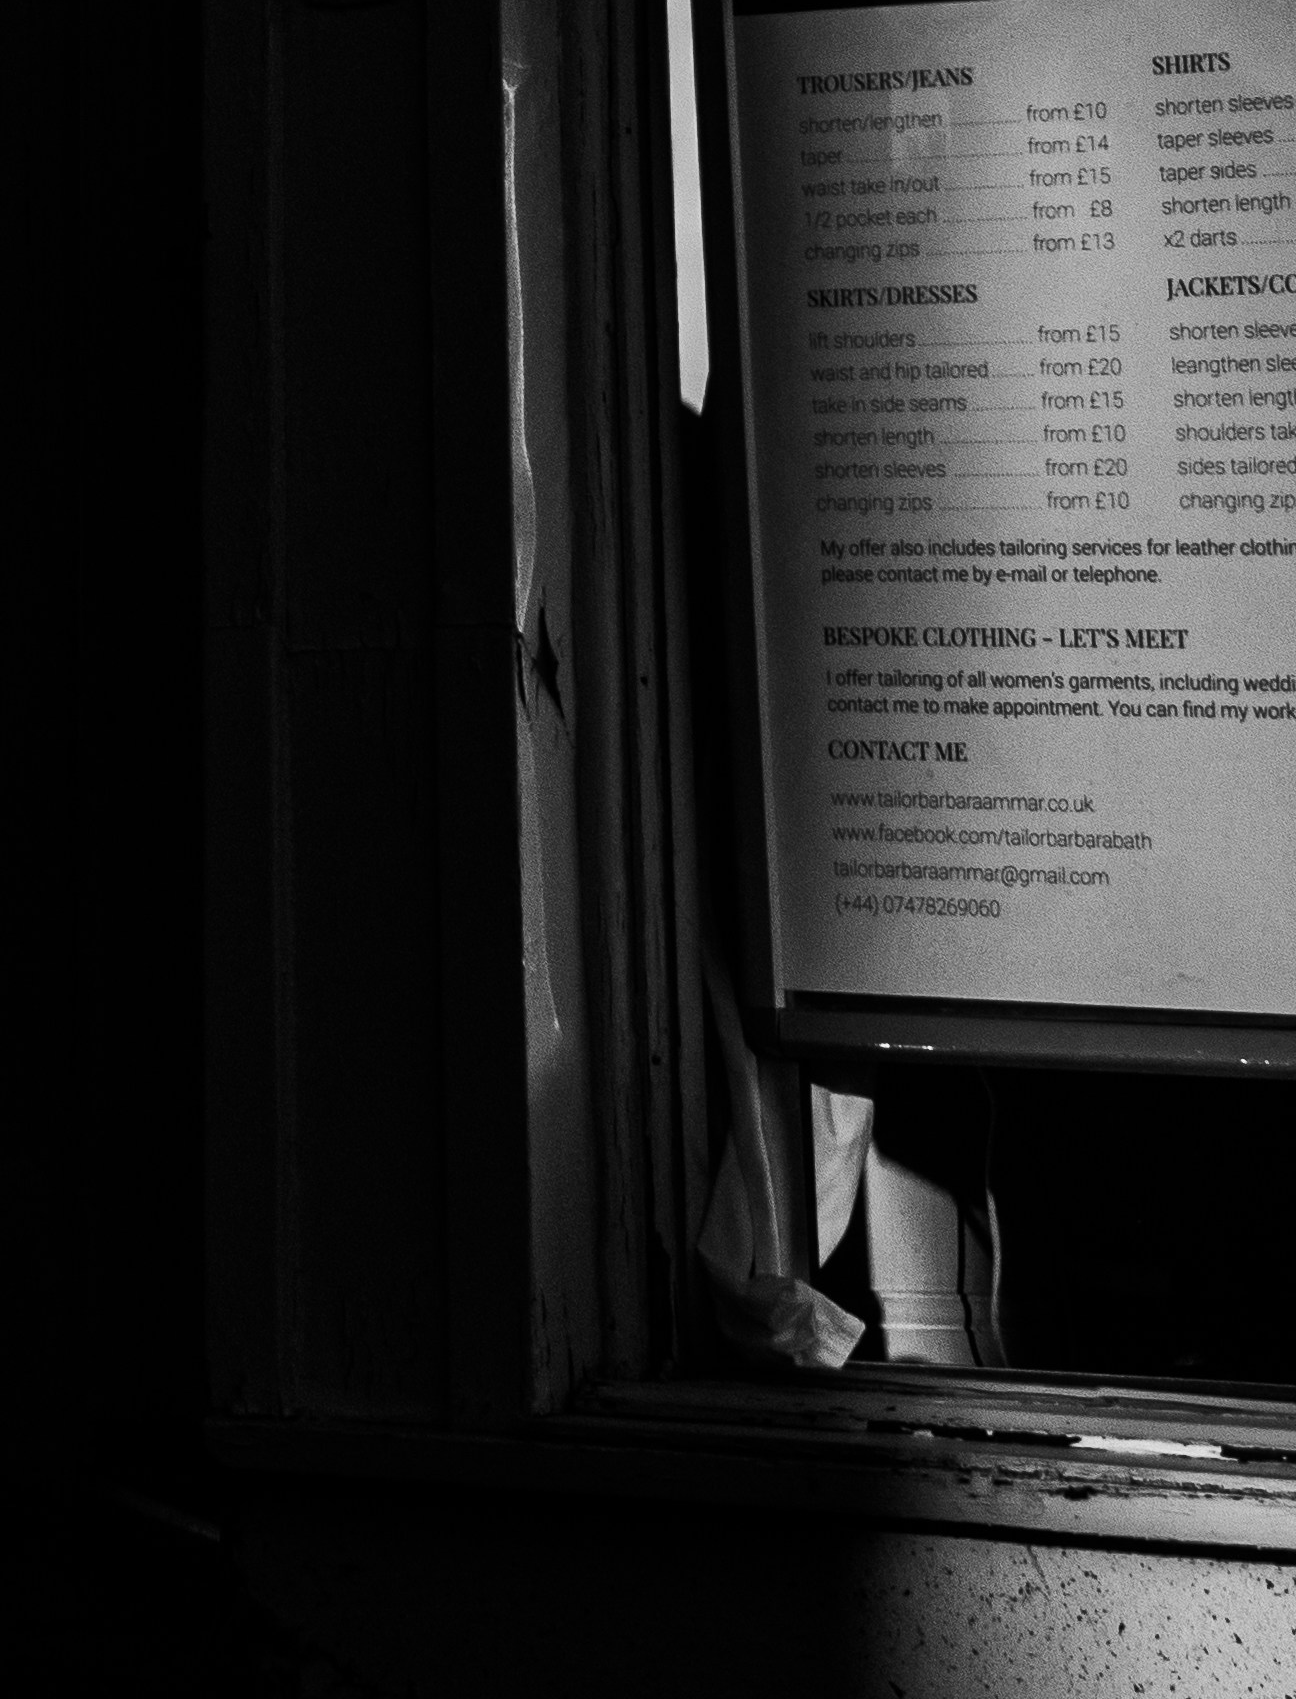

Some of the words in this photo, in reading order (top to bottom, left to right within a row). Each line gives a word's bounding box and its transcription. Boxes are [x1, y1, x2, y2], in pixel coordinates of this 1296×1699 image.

[1152, 52, 1231, 75] SHIRTS
[797, 67, 974, 94] TROUSERS/JEANS
[1026, 105, 1069, 122] from
[1073, 102, 1107, 121] £10
[1155, 98, 1222, 117] shorten
[1228, 94, 1294, 113] sleeves
[801, 150, 842, 167] taper
[1028, 137, 1070, 154] from
[1075, 135, 1109, 153] £14
[1157, 133, 1203, 151] taper
[1208, 129, 1274, 147] sleeves
[801, 180, 845, 197] waist
[851, 178, 886, 195] take
[890, 175, 940, 194] in/out
[1030, 169, 1072, 187] from
[1077, 167, 1111, 186] £15
[1159, 165, 1205, 184] taper
[1210, 161, 1257, 179] sides
[836, 209, 892, 228] pocket
[896, 209, 937, 224] each
[1033, 201, 1075, 219] from
[1090, 200, 1113, 218] £8
[1162, 195, 1230, 215] shorten
[1235, 191, 1291, 215] length
[805, 243, 882, 263] changing
[886, 241, 920, 260] zips
[1033, 233, 1075, 252] from
[1081, 232, 1115, 250] £13
[1164, 230, 1186, 247] x2
[1190, 228, 1238, 247] darts
[807, 284, 978, 308] SKIRTS/DRESSES
[834, 330, 916, 349] shoulders
[1038, 325, 1081, 342] from
[1086, 325, 1120, 342] £15
[1169, 323, 1239, 341] shorten
[811, 364, 855, 381] waist
[859, 362, 890, 381] and
[895, 362, 921, 383] hip
[925, 360, 989, 379] tailored
[1040, 358, 1082, 376] from
[1088, 358, 1122, 376] £20
[1172, 355, 1260, 378] leangthen
[812, 397, 846, 414] take
[852, 395, 866, 413] in
[871, 396, 905, 413] side
[909, 397, 967, 412] seams
[1041, 391, 1084, 409] from
[1090, 391, 1124, 409] £15
[1174, 389, 1243, 408] shorten
[1249, 388, 1296, 411] lengt
[814, 429, 877, 447] shorten
[882, 427, 934, 449] length
[1044, 425, 1086, 442] from
[1092, 424, 1126, 442] £10
[1175, 423, 1265, 442] shoulders
[815, 462, 879, 479] shorten
[883, 461, 946, 478] sleeves
[1045, 458, 1088, 476] from
[1094, 458, 1127, 476] £20
[1177, 457, 1225, 475] sides
[1231, 456, 1296, 475] tailored
[815, 495, 894, 515] changing
[899, 493, 933, 512] zips
[1047, 491, 1089, 510] from
[1096, 491, 1129, 509] £10
[1179, 492, 1264, 513] changing
[821, 540, 845, 560] My
[849, 538, 886, 556] offer
[890, 539, 924, 556] also
[928, 539, 995, 556] includes
[1000, 539, 1067, 560] tailoring
[1072, 539, 1142, 556] services
[1147, 538, 1171, 556] for
[1176, 538, 1235, 556] leather
[821, 566, 873, 585] please
[877, 566, 938, 583] contact
[943, 568, 968, 583] me
[973, 565, 992, 586] by
[997, 565, 1047, 583] e-mail
[1051, 569, 1068, 583] or
[1073, 566, 1161, 586] telephone.
[823, 626, 918, 646] BESPOKE
[922, 627, 1036, 648] CLOTHING
[1125, 629, 1189, 649] MEET
[835, 669, 873, 687] offer
[878, 669, 943, 692] tailoring
[947, 670, 964, 688] of
[968, 671, 986, 688] all
[990, 671, 1064, 689] women's
[1069, 675, 1155, 693] garments,
[1160, 673, 1239, 696] including
[828, 698, 889, 714] contact
[893, 700, 919, 714] me
[923, 699, 940, 714] to
[944, 698, 988, 715] make
[993, 698, 1103, 719] appointment.
[1109, 701, 1141, 717] You
[1146, 703, 1178, 717] can
[1183, 700, 1216, 718] find
[1221, 703, 1248, 723] my
[828, 739, 929, 762] CONTACT
[935, 742, 968, 762] ME
[835, 893, 879, 916] (+44)
